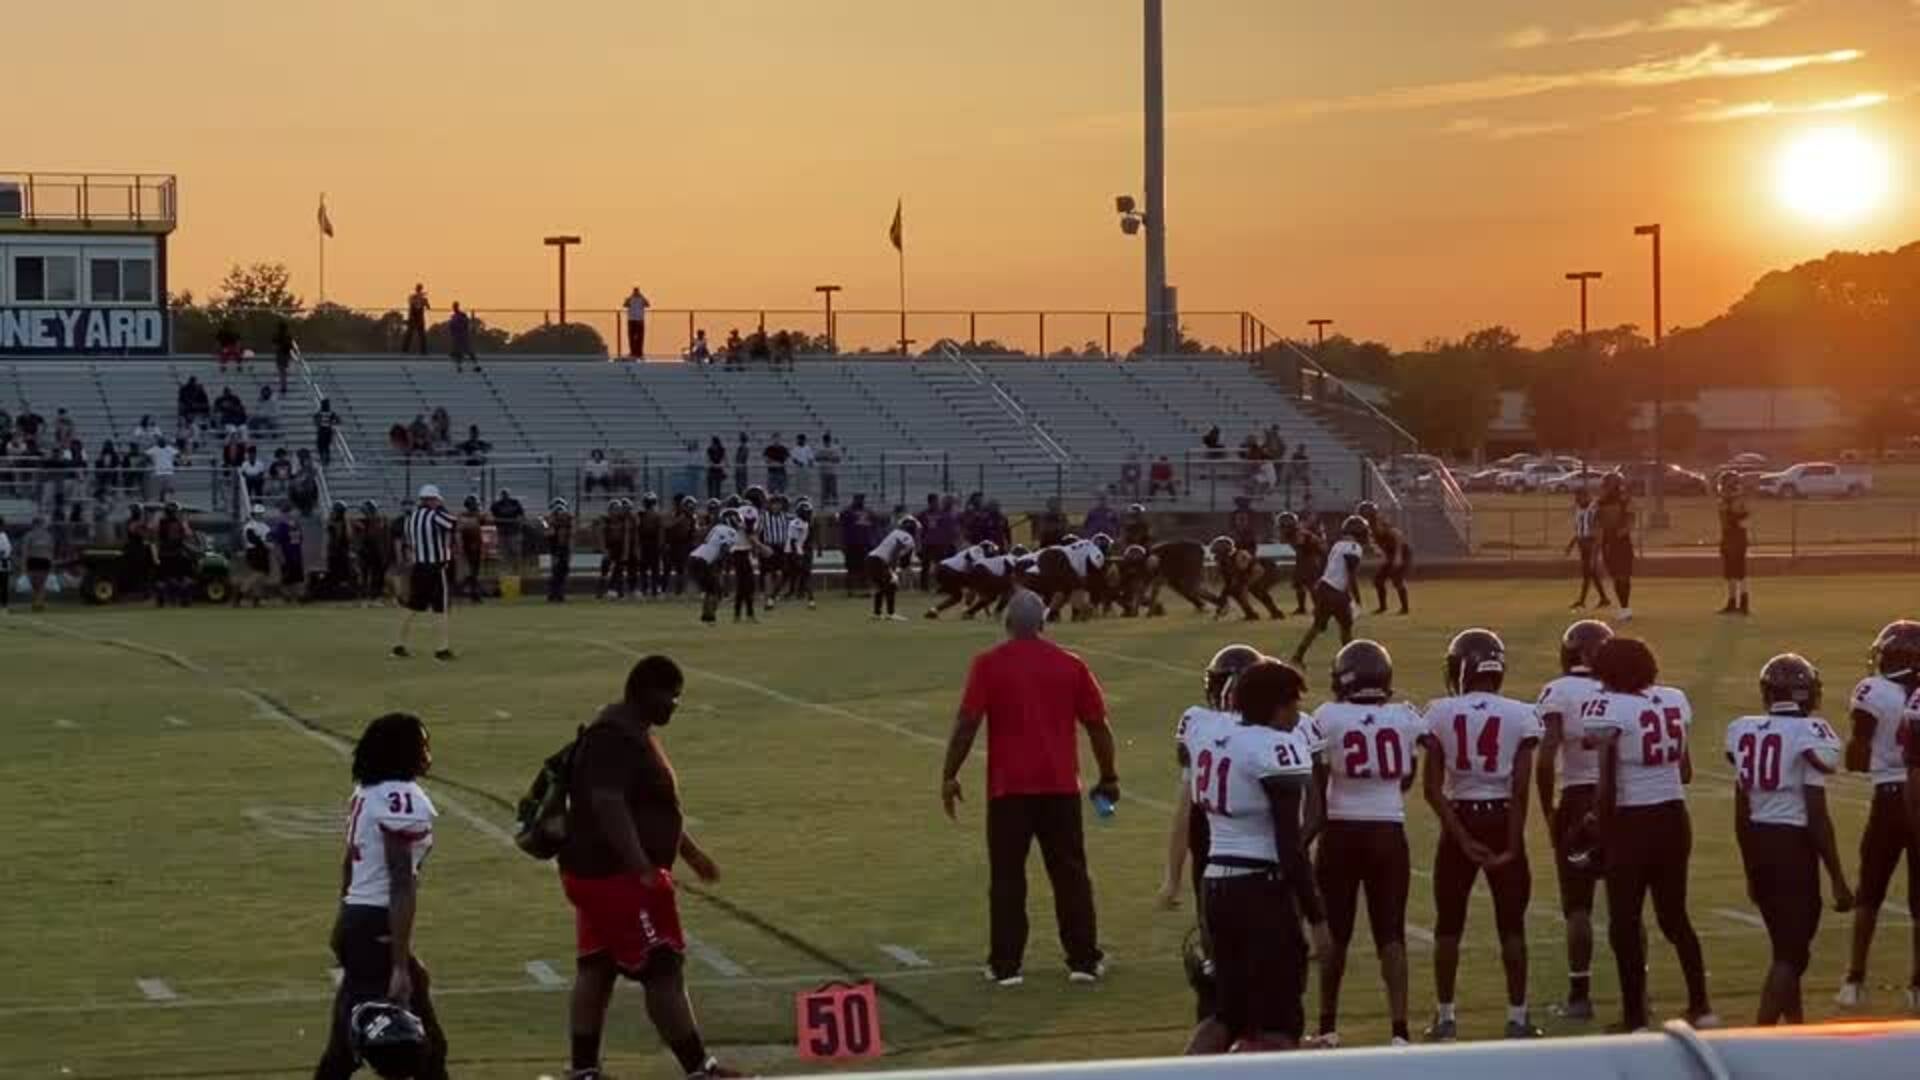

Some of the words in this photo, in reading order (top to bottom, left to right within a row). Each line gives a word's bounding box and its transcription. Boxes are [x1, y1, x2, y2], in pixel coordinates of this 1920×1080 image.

[0, 310, 162, 347] NEYARD
[1274, 744, 1301, 766] 21
[1343, 727, 1403, 780] 20
[1453, 714, 1502, 772] 14
[1640, 707, 1682, 765] 25
[1738, 733, 1782, 791] 30
[388, 791, 414, 814] 31
[1197, 750, 1231, 817] 21
[806, 993, 870, 1056] 50
